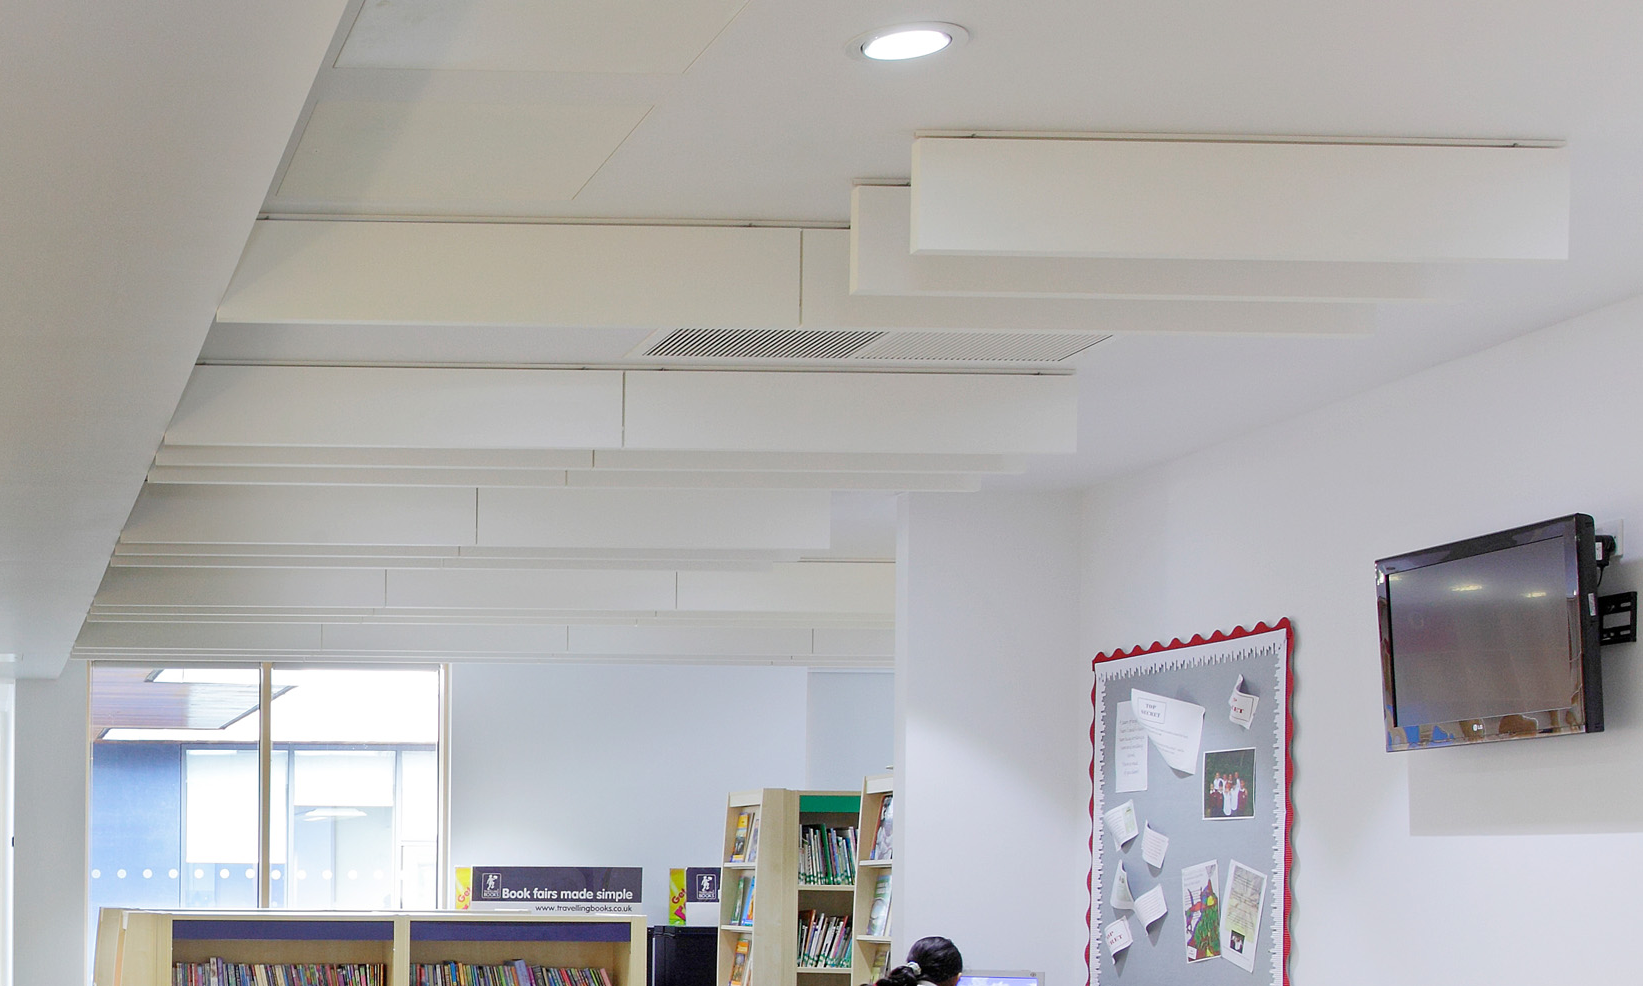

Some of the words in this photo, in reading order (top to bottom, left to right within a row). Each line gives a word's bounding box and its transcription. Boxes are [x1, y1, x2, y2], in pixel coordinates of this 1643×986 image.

[1140, 709, 1161, 718] SECRET
[502, 887, 531, 899] Book
[532, 887, 558, 899] fairs
[560, 888, 594, 900] made
[596, 888, 633, 902] simple
[535, 904, 633, 914] www.travellingbooks.co.uk
